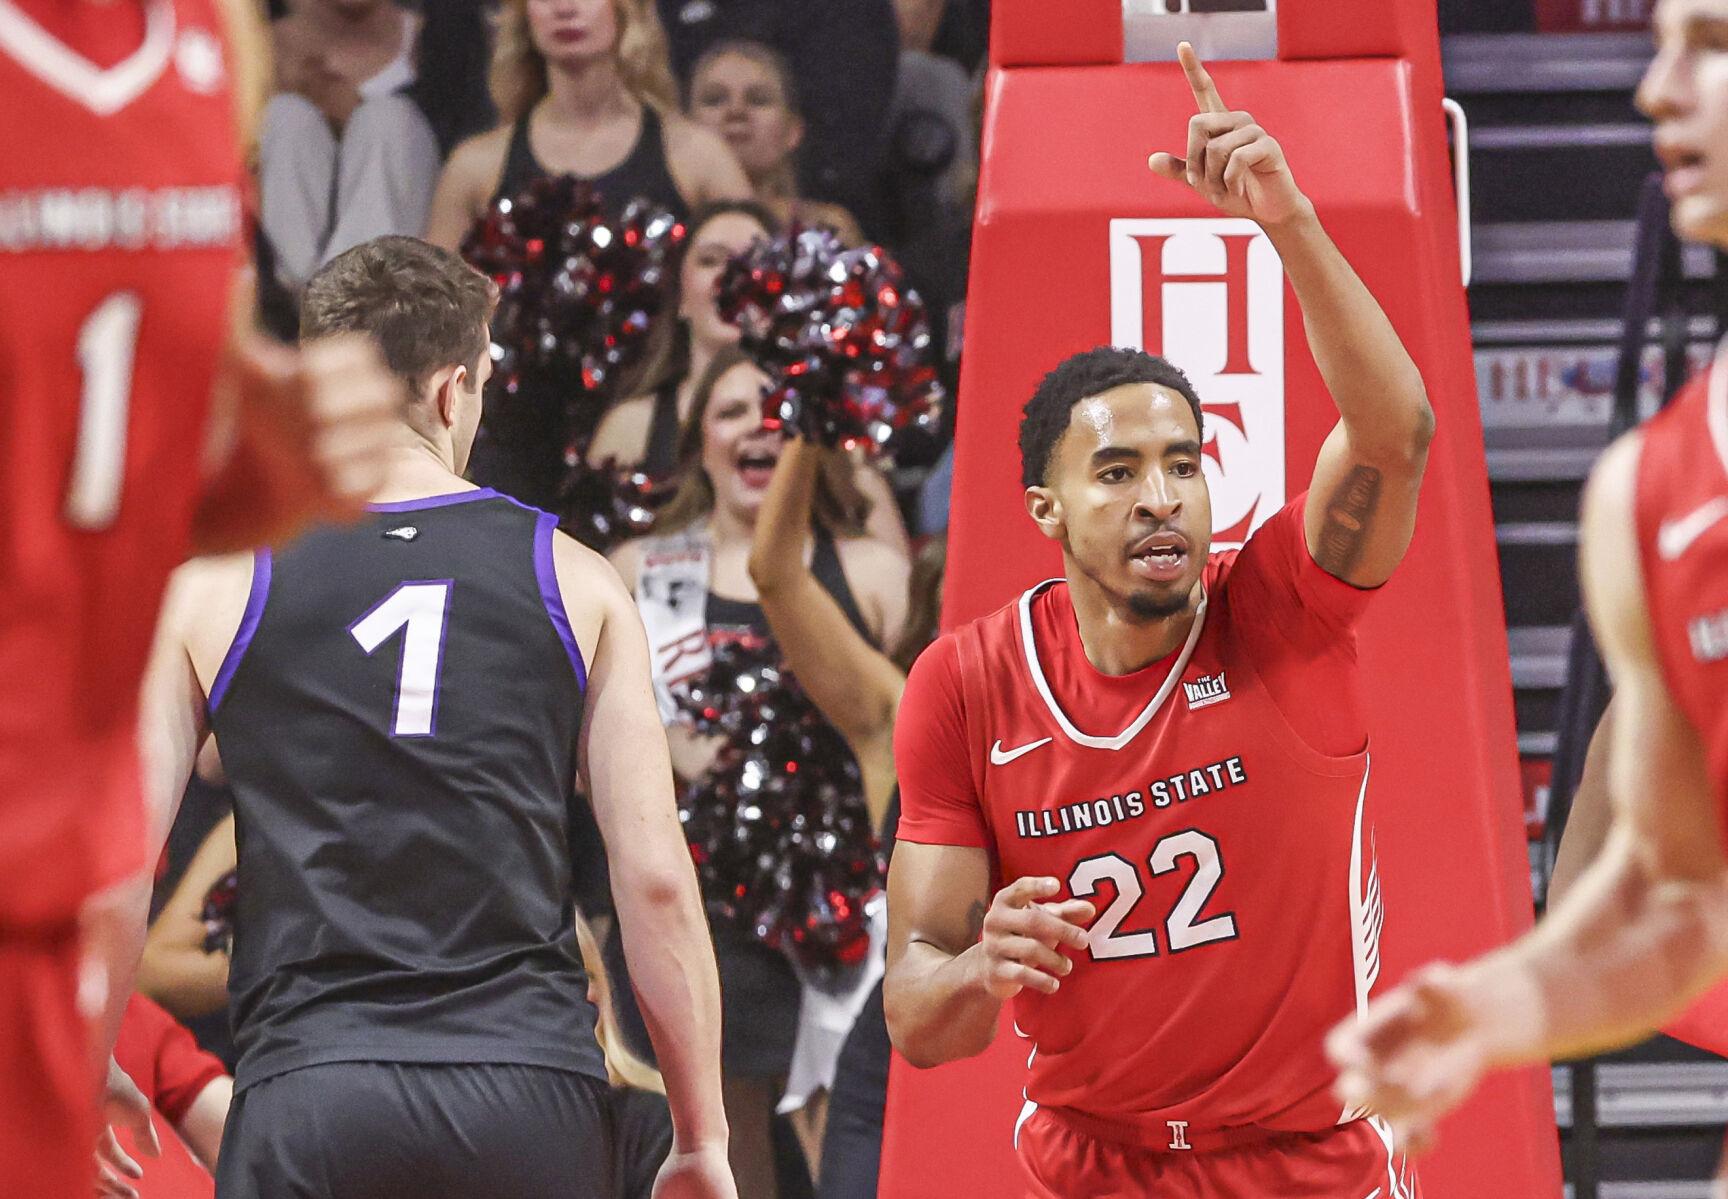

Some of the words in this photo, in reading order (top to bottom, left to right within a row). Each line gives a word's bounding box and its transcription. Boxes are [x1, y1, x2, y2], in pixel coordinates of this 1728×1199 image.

[64, 289, 143, 530] 1
[346, 579, 454, 738] 1
[1183, 671, 1227, 702] VALLEY
[1016, 791, 1145, 838] ILLINOIS
[1150, 756, 1247, 809] STATE
[1067, 827, 1239, 961] 22
